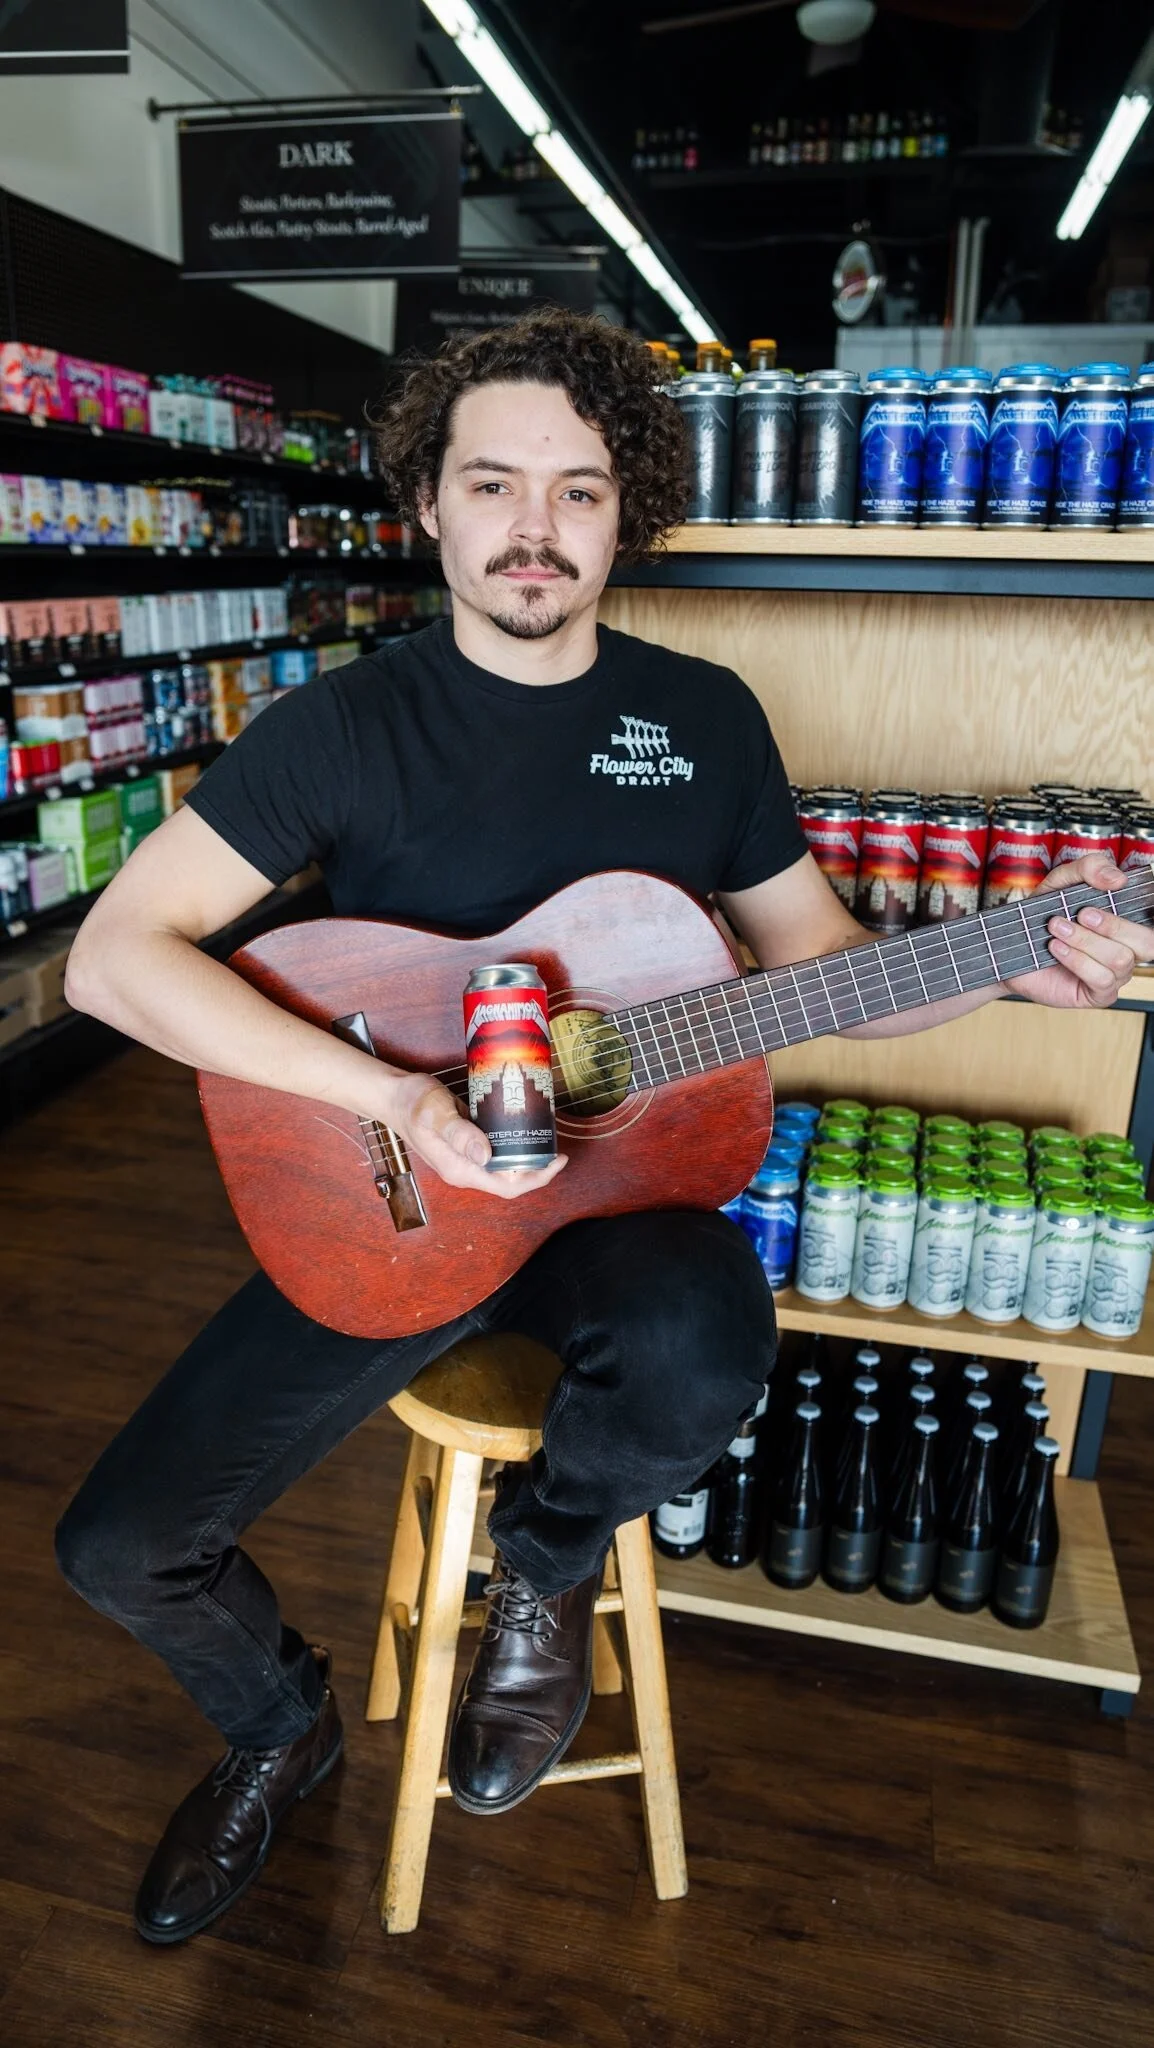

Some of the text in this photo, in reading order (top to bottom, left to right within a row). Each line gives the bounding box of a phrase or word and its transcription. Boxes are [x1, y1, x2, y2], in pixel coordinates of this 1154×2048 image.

[278, 141, 354, 168] DARK
[589, 754, 694, 781] Flower City
[616, 776, 671, 786] DRAFT
[485, 1131, 512, 1139] STER
